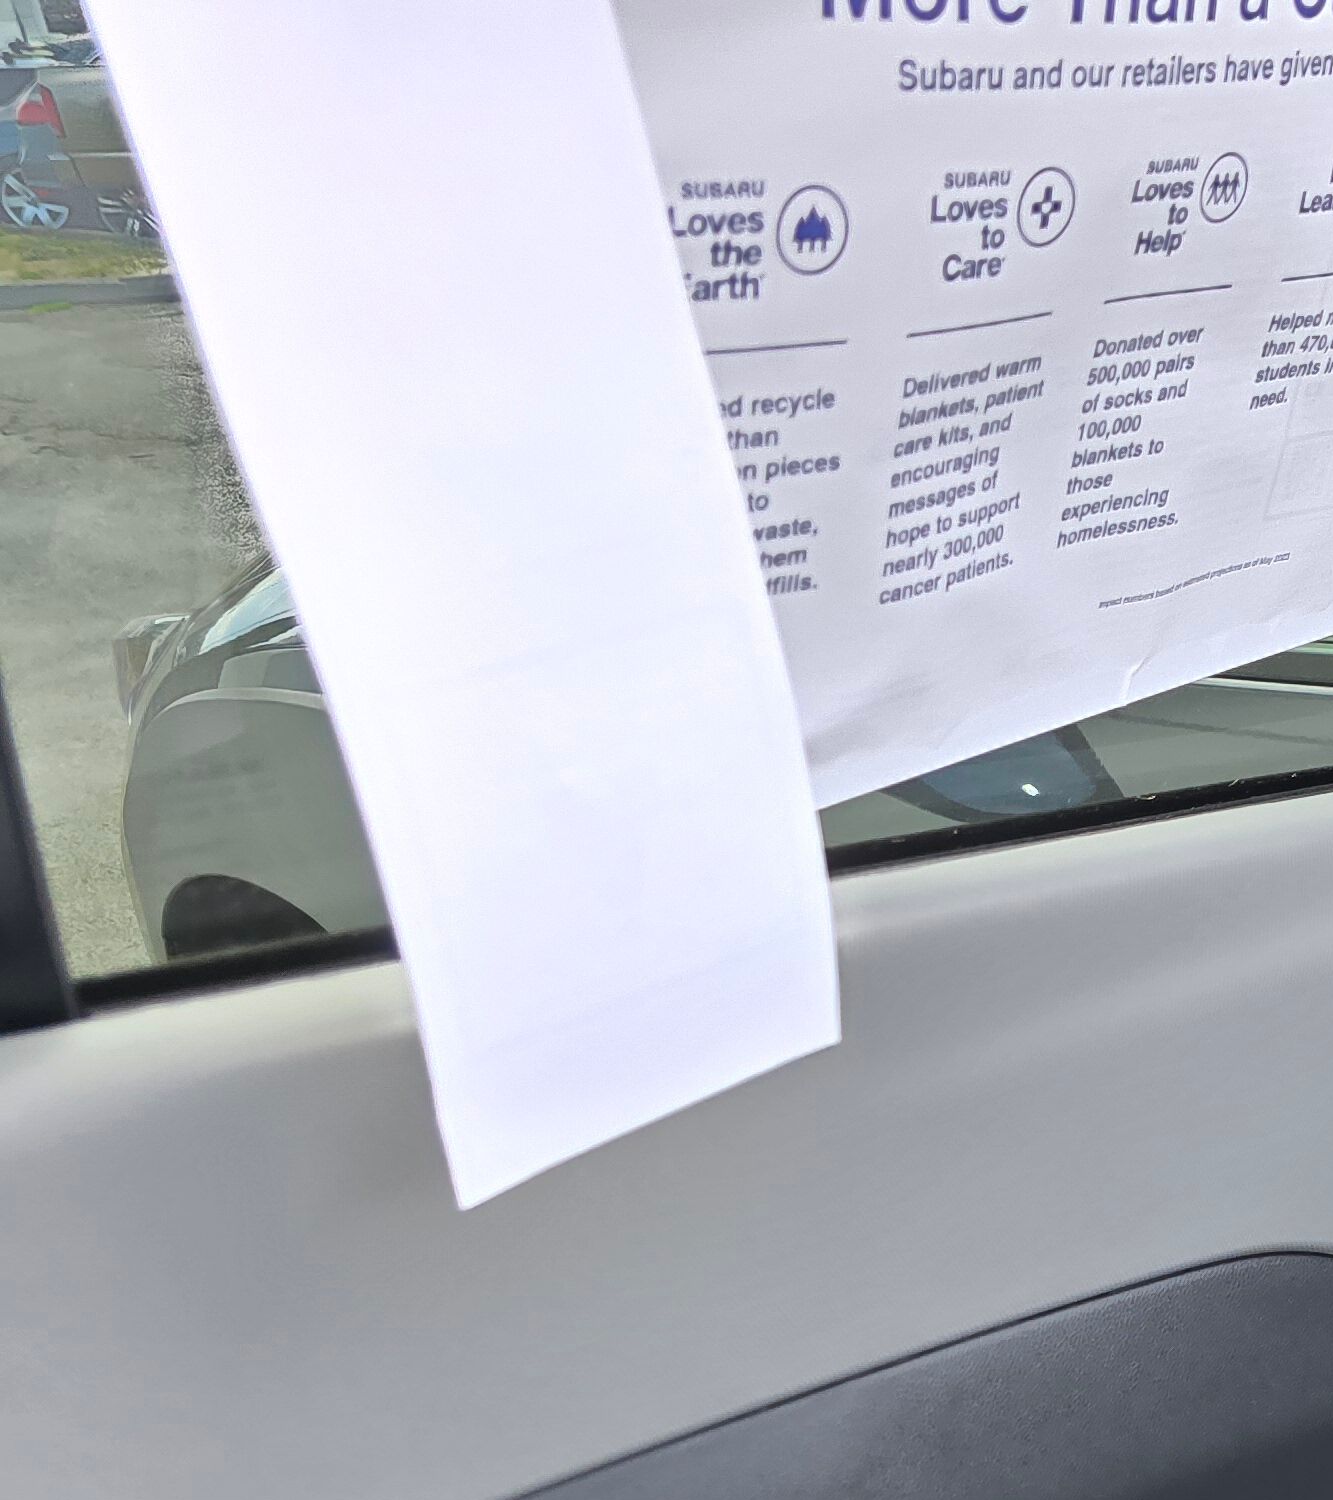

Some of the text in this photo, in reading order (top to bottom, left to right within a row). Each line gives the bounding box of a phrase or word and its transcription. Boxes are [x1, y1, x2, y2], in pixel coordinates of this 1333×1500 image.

[899, 58, 1004, 91] Subaru
[1013, 59, 1063, 89] and
[1071, 65, 1114, 88] our
[1121, 55, 1216, 88] retailers
[1224, 55, 1274, 83] have
[1280, 50, 1333, 85] given
[1146, 156, 1199, 174] SUBARU
[681, 180, 766, 199] SUBARU
[944, 171, 1010, 188] SUBARU
[1131, 180, 1193, 203] Loves
[668, 206, 764, 237] Loves
[930, 196, 1007, 223] Loves
[1168, 204, 1188, 225] to
[981, 226, 1004, 249] to
[1134, 231, 1182, 256] Help
[711, 240, 762, 267] the
[943, 255, 1001, 281] Care
[685, 273, 760, 301] arth
[1268, 310, 1322, 334] Helped
[1093, 326, 1204, 358] Donated over
[1261, 339, 1296, 358] than
[903, 356, 1042, 399] Delivered warm
[1087, 354, 1195, 387] 500,000 pairs
[1255, 360, 1320, 384] students
[751, 388, 836, 418] recycle
[899, 379, 1045, 429] blankets, patient
[1081, 379, 1189, 414] of socks and
[1249, 388, 1288, 411] need.
[893, 413, 1012, 458] care kits, and
[1077, 414, 1142, 442] 100,000
[890, 446, 1000, 488] encouraging
[1071, 438, 1164, 469] blankets to
[765, 455, 841, 483] pieces
[888, 470, 1000, 519] messages of
[1066, 472, 1113, 495] those
[1061, 488, 1170, 523] experiencing
[885, 492, 1020, 550] hope to support
[1056, 512, 1179, 549] homelessness.
[760, 548, 807, 569] hem
[882, 524, 1004, 577] nearly 300,000
[879, 551, 1014, 605] cancer patients.
